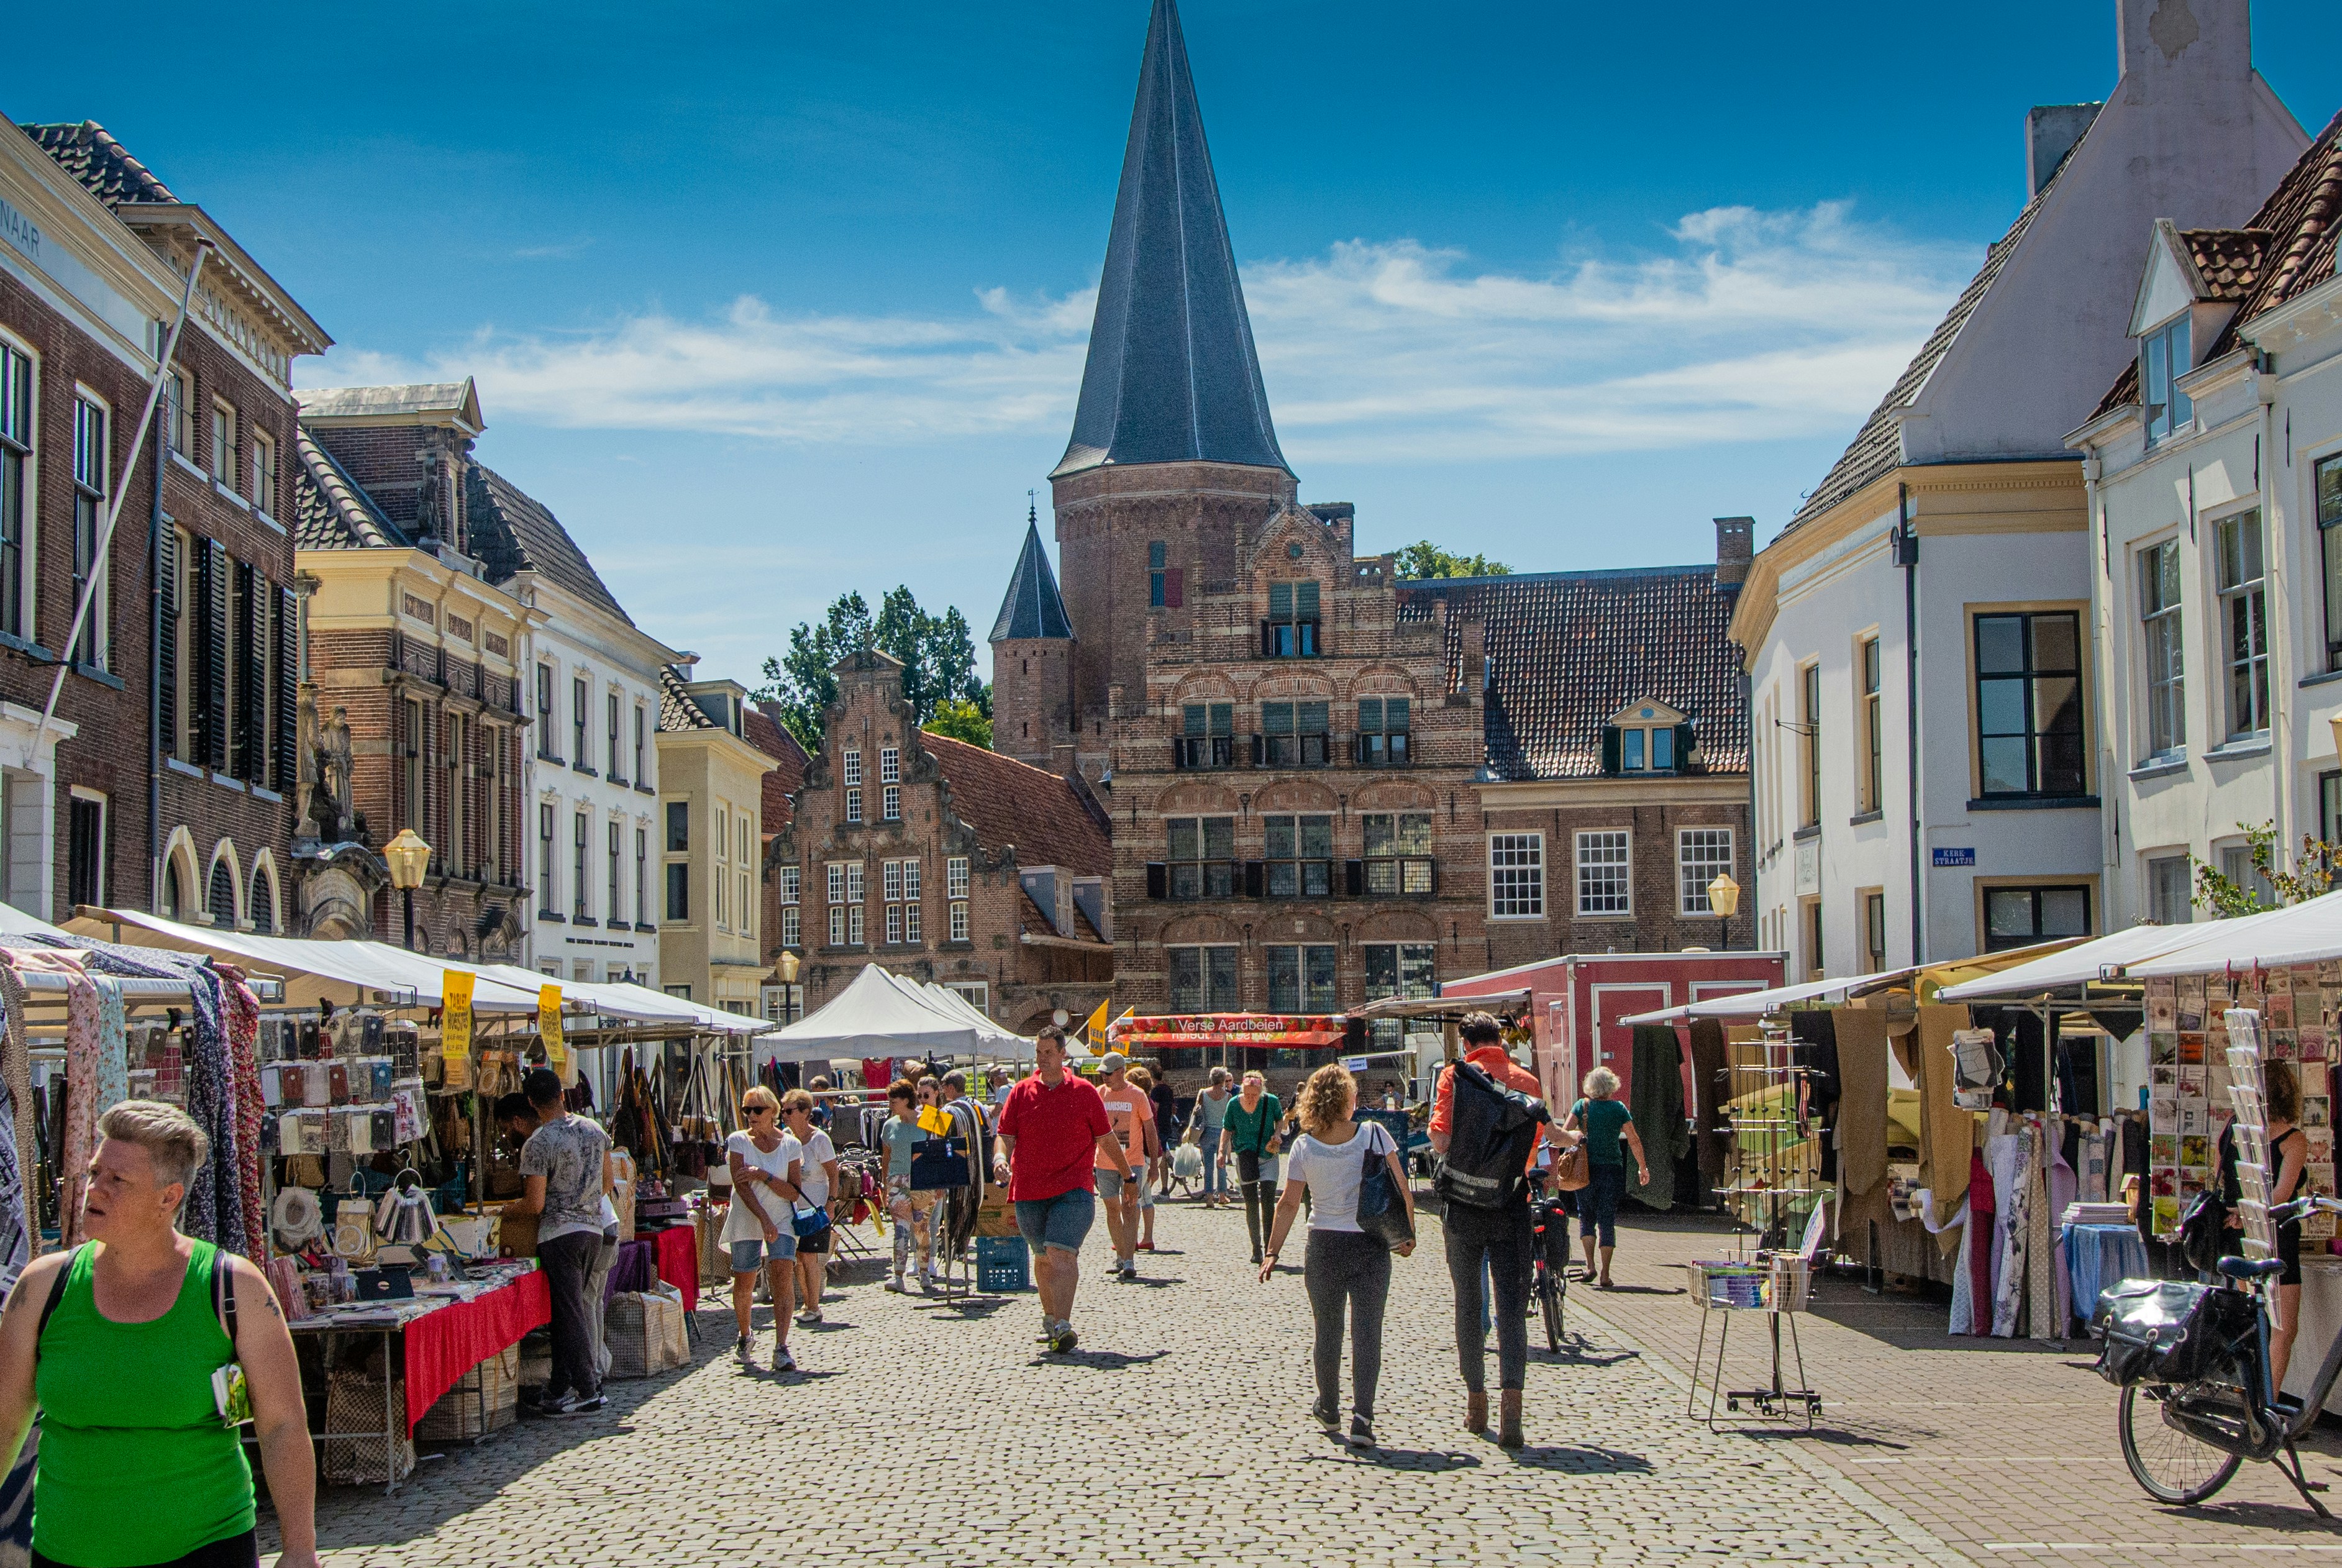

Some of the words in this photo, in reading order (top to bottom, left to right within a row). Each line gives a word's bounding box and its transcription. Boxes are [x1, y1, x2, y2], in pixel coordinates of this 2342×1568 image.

[1178, 1019, 1214, 1031] Verse
[1218, 1019, 1283, 1031] Aardbeien
[1747, 1286, 1756, 1306] VARTA
